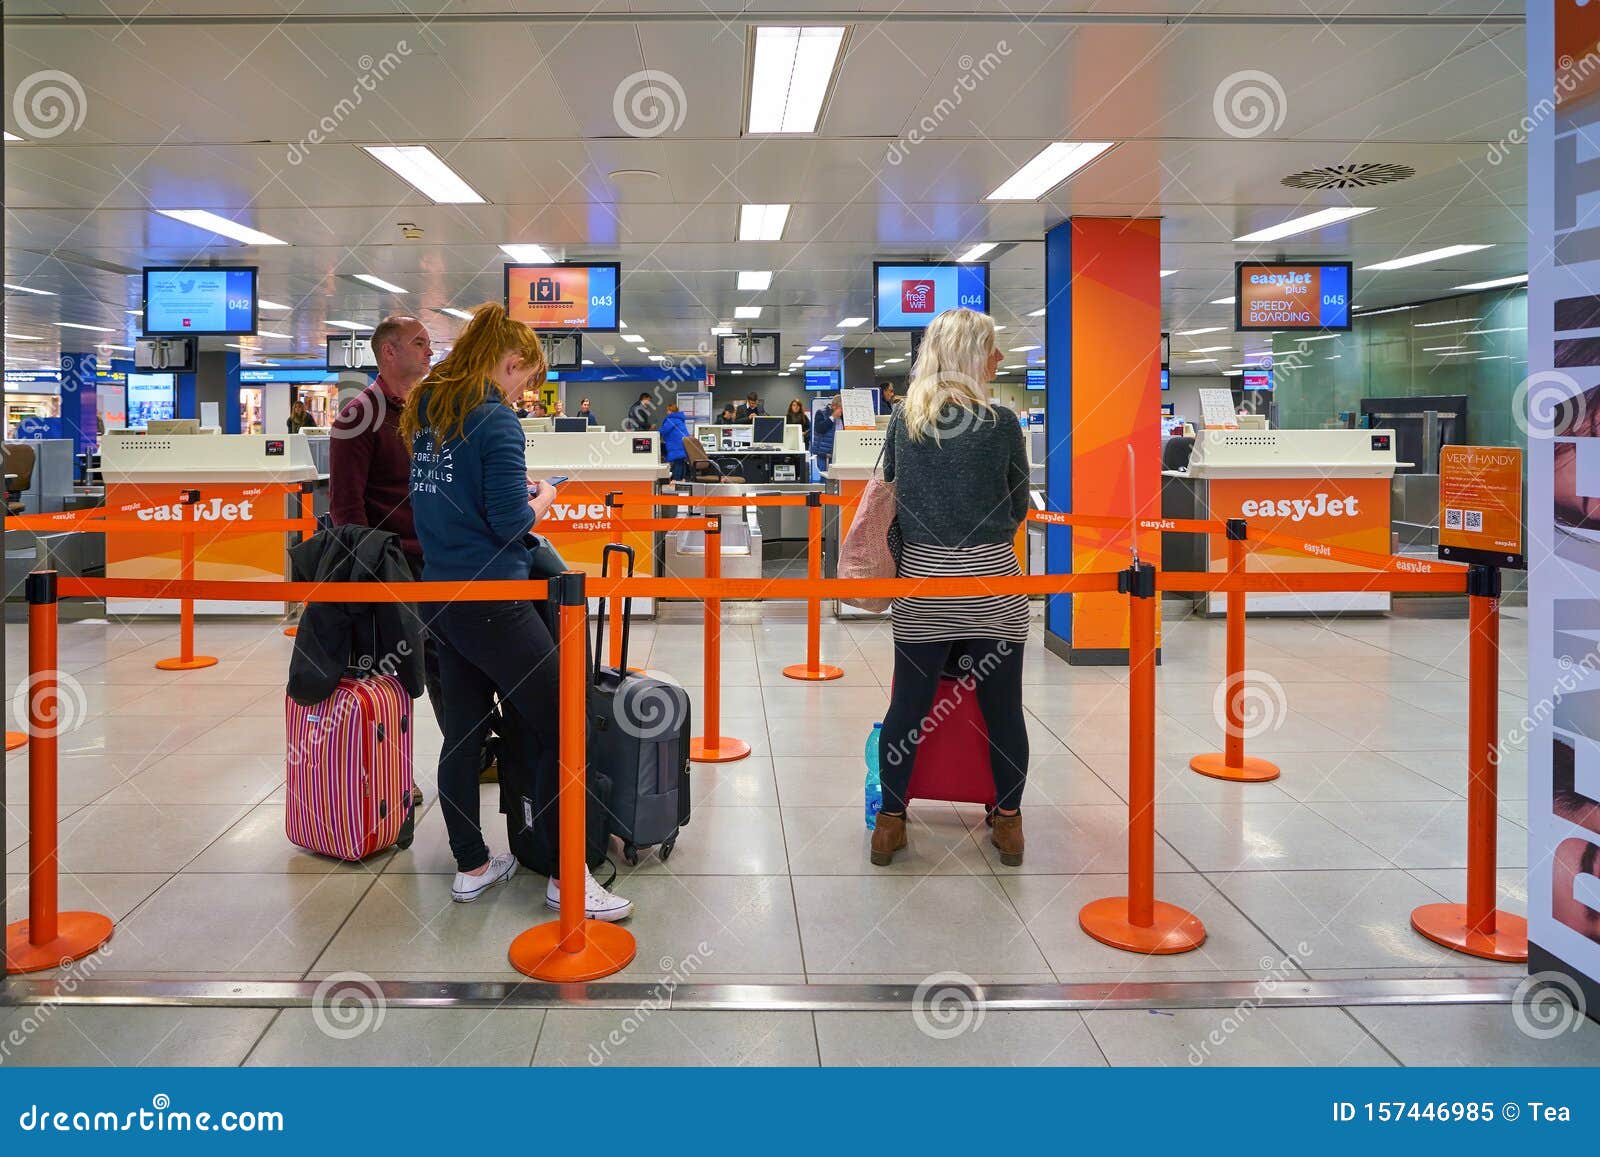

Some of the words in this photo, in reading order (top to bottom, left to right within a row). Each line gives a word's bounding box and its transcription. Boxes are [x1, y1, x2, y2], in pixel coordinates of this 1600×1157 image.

[1250, 271, 1312, 286] easyJet
[905, 290, 926, 302] free
[1285, 285, 1307, 296] plus
[228, 300, 249, 310] 042
[591, 295, 612, 306] 043
[961, 295, 982, 305] 044
[1323, 295, 1344, 305] 045
[1250, 301, 1293, 311] SPEEDY
[564, 318, 585, 326] easyJet
[1250, 312, 1310, 322] BOARDING
[1446, 453, 1472, 465] VERY
[1475, 455, 1515, 466] HANDY
[1241, 493, 1359, 522] easyJet
[1035, 512, 1065, 523] easyJet
[572, 521, 611, 531] easyJet
[1140, 519, 1176, 530] easyJet
[1304, 542, 1331, 556] easyJet
[1396, 560, 1432, 574] easyJet
